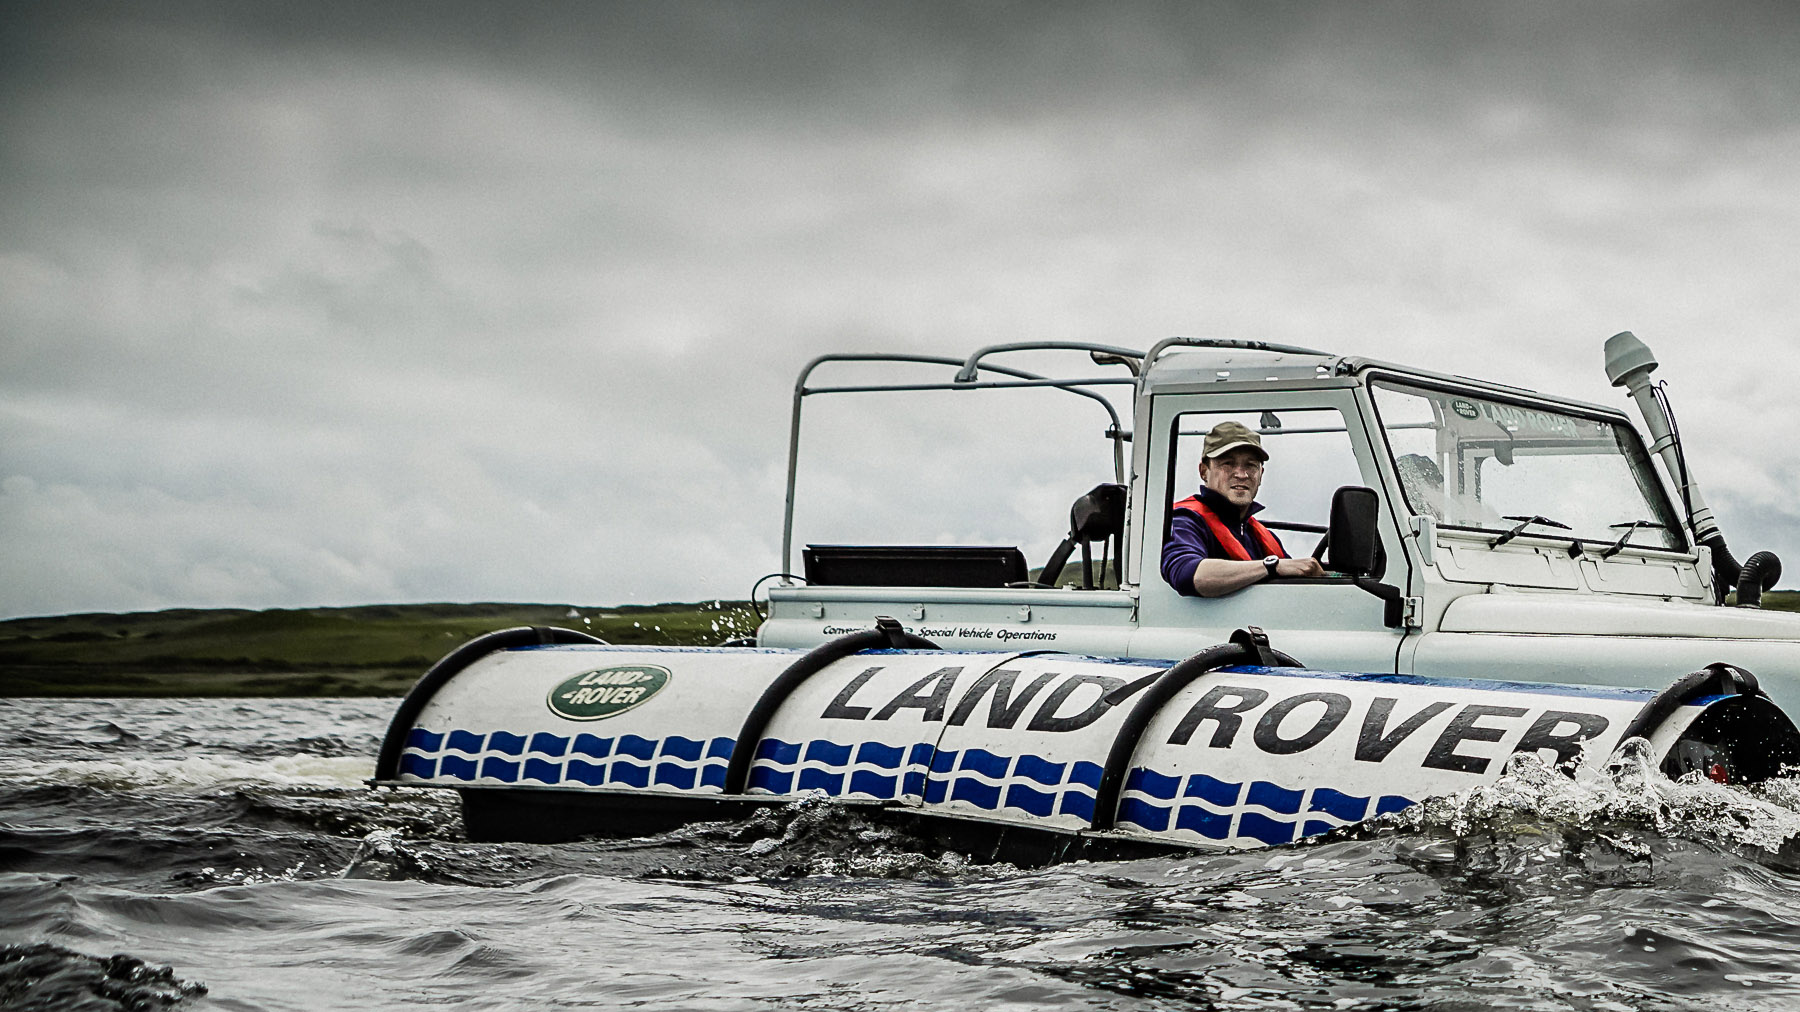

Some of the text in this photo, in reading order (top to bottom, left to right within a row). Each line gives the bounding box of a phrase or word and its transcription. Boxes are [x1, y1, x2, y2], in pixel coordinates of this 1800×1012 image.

[1526, 411, 1579, 438] ROVER
[917, 626, 957, 638] Special
[958, 627, 994, 639] Vehicle
[996, 628, 1058, 642] Operations
[578, 670, 646, 686] LAND
[569, 687, 647, 704] ROVER
[820, 666, 1610, 780] LAND ROVER
